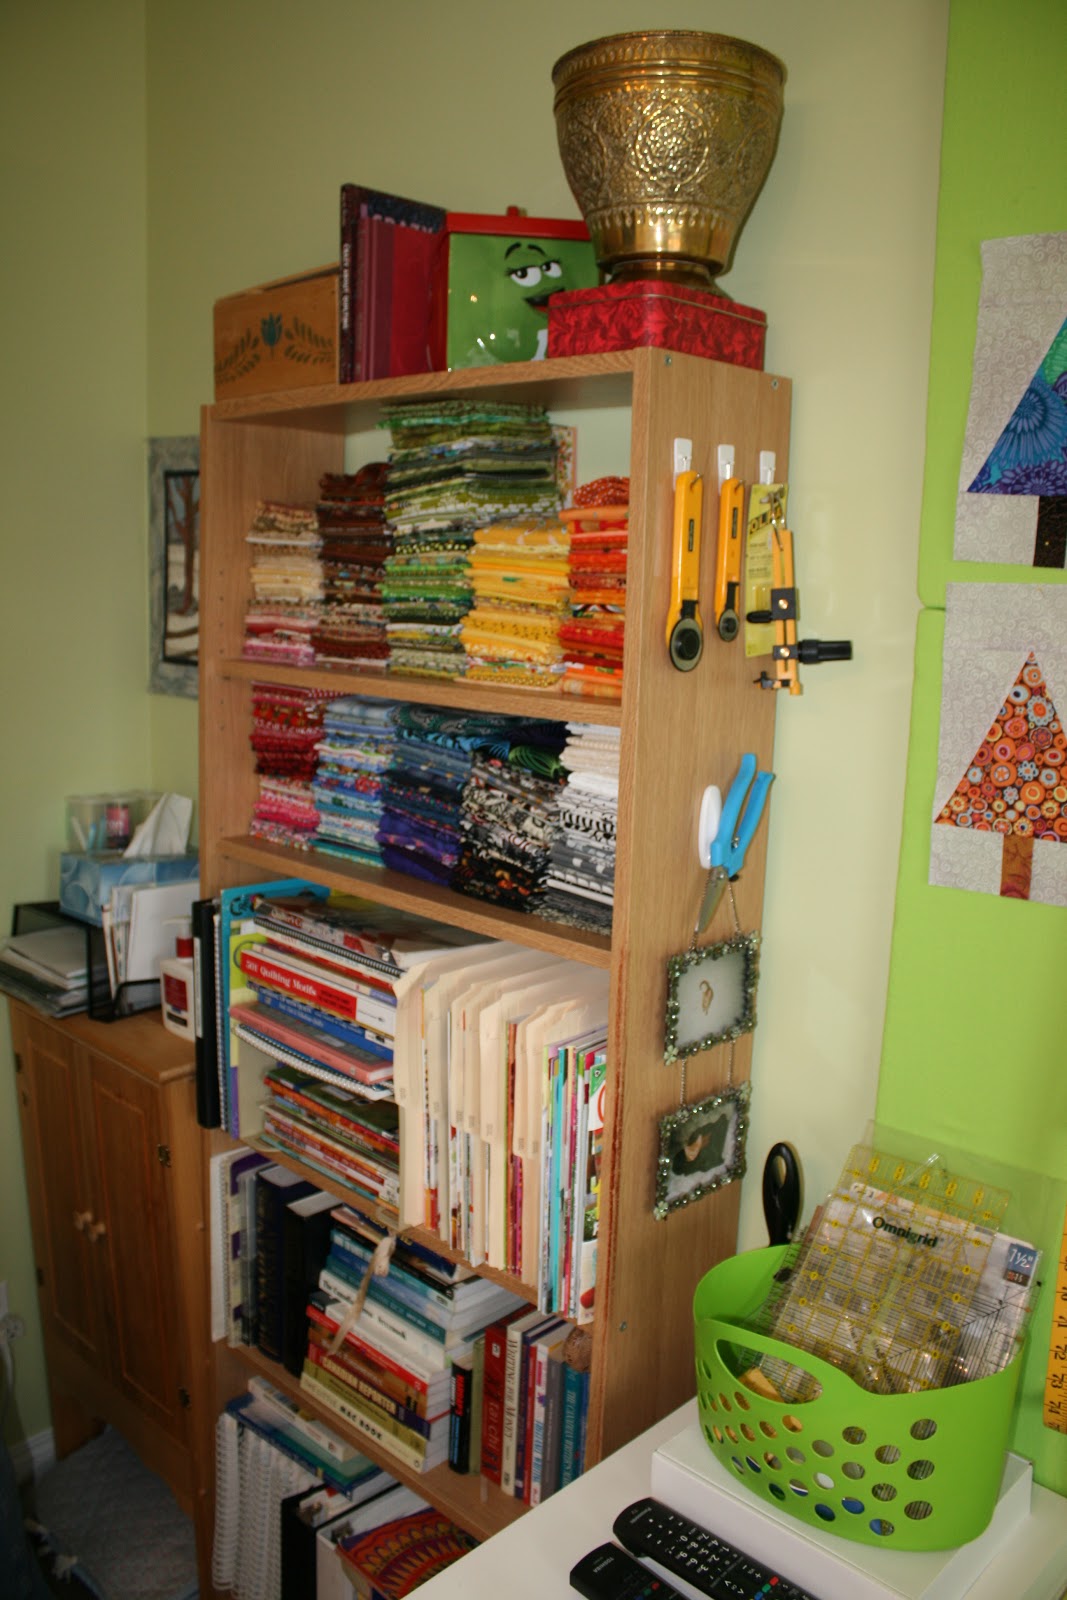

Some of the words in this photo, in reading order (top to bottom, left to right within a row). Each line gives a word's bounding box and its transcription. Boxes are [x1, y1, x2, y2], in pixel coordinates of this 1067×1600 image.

[260, 965, 291, 989] Quilting
[292, 978, 318, 997] Motifs
[872, 1216, 939, 1249] Omnigrid
[1054, 1345, 1067, 1361] 72
[1051, 1373, 1065, 1389] 73
[1048, 1400, 1062, 1415] 74
[340, 1405, 358, 1421] MAC
[360, 1420, 382, 1441] BOOK
[593, 1556, 615, 1573] TOSHIBA
